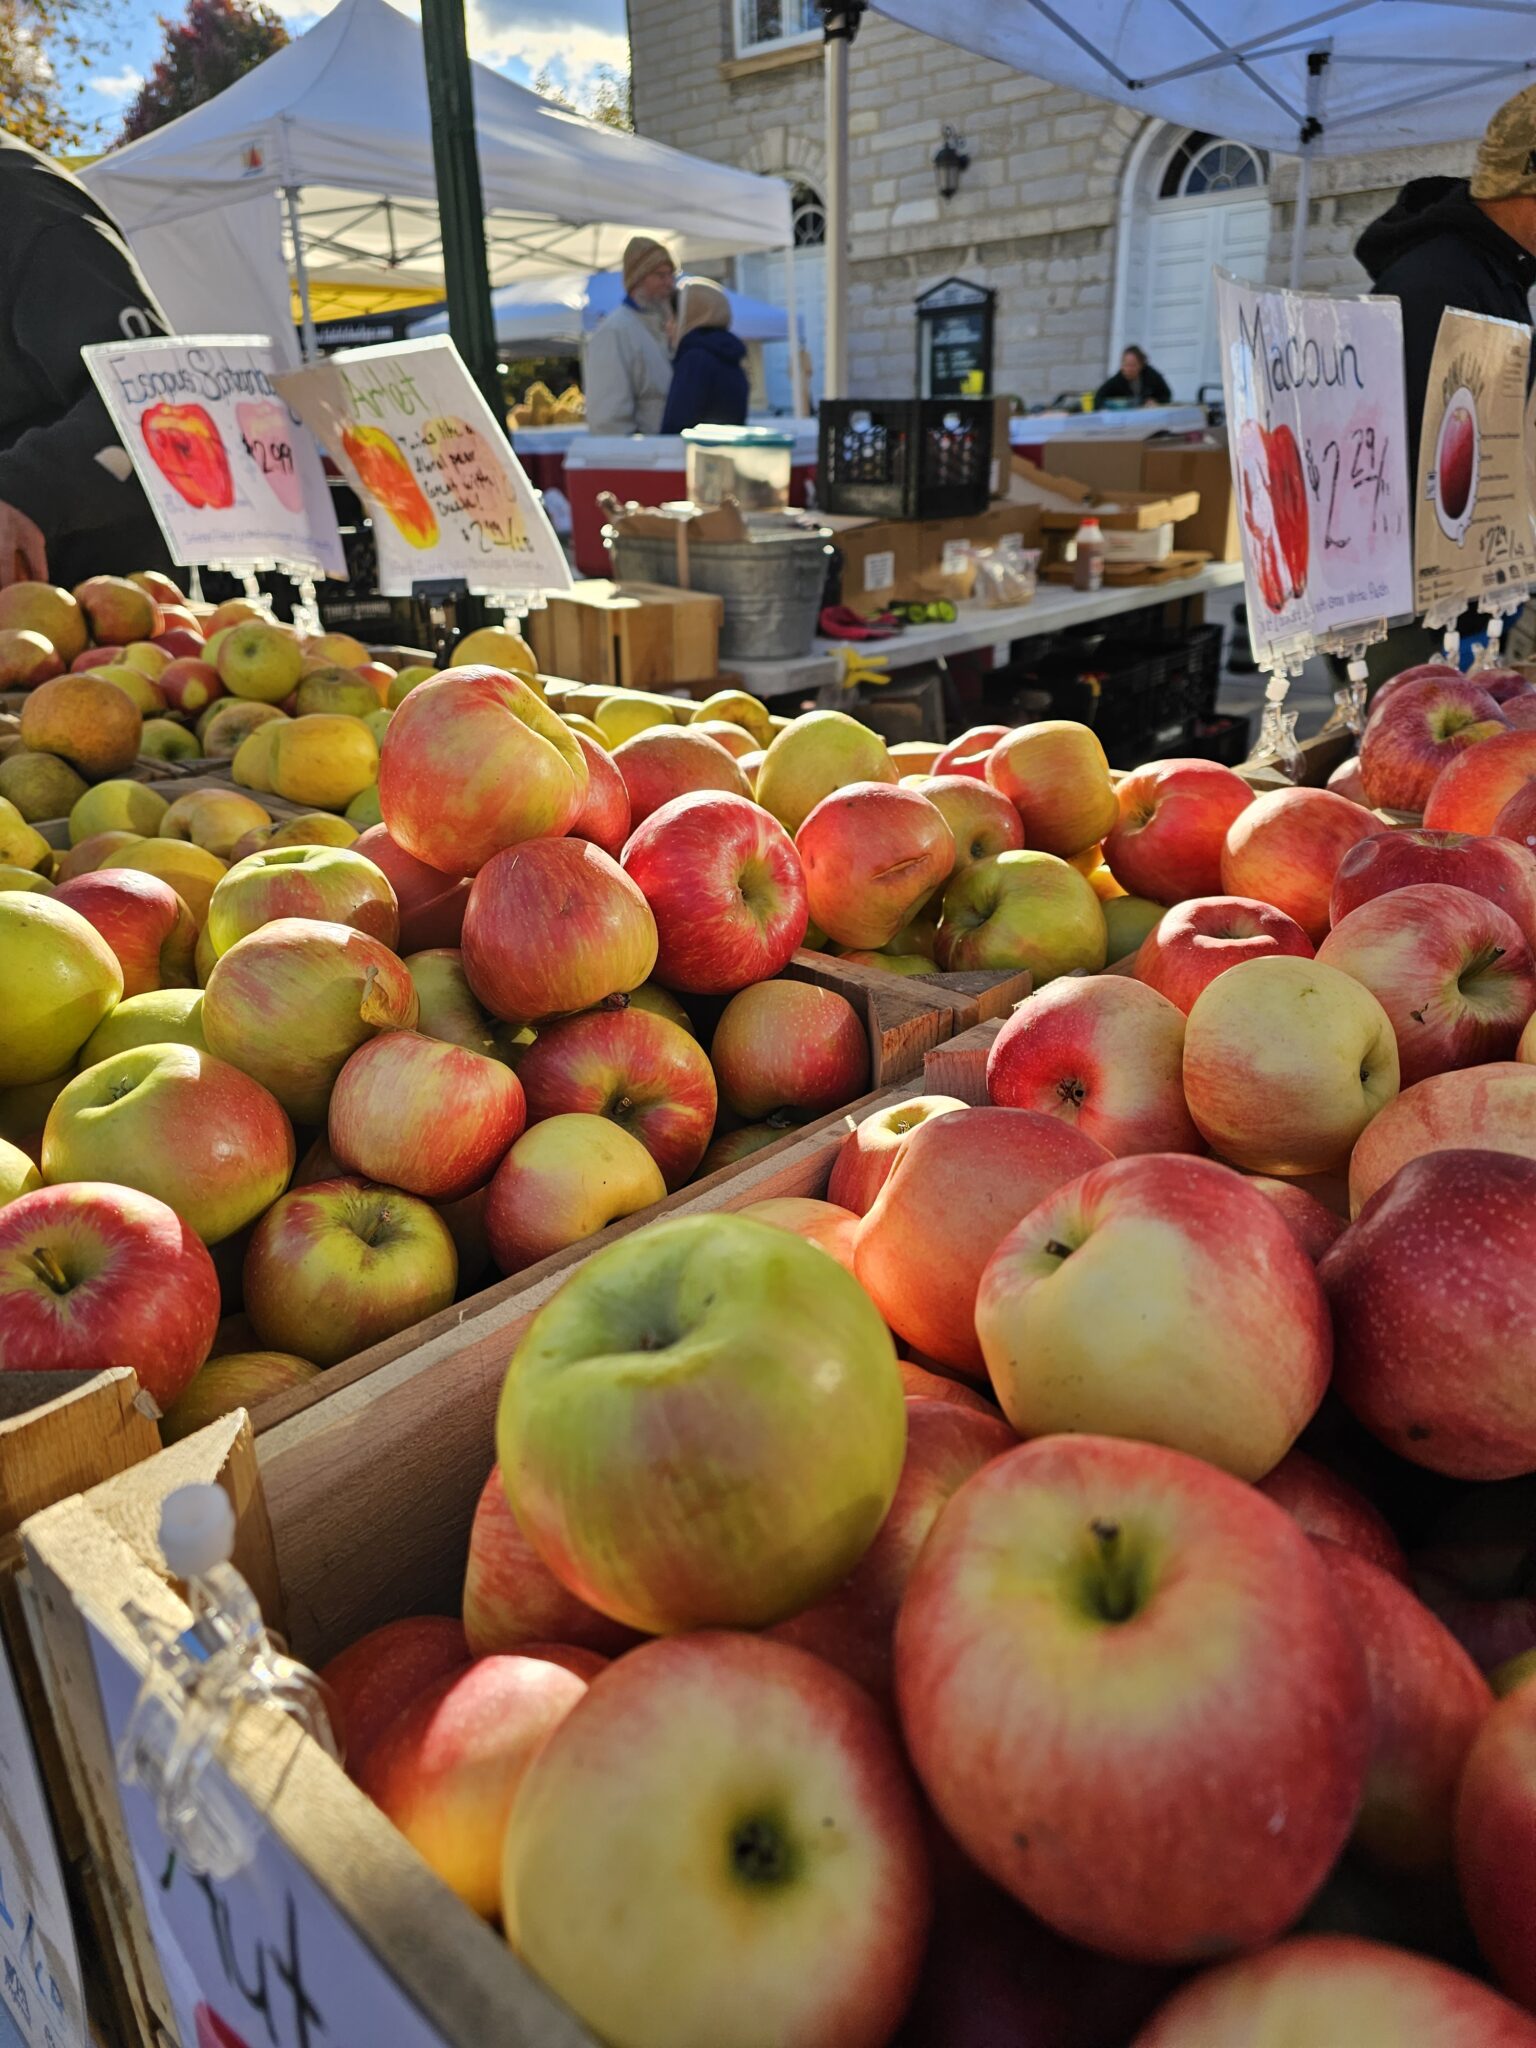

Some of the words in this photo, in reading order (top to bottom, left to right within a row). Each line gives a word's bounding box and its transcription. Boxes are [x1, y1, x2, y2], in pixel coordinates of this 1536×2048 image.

[1239, 303, 1364, 404] Macoun
[109, 356, 197, 404] Esopus
[448, 450, 476, 475] pear
